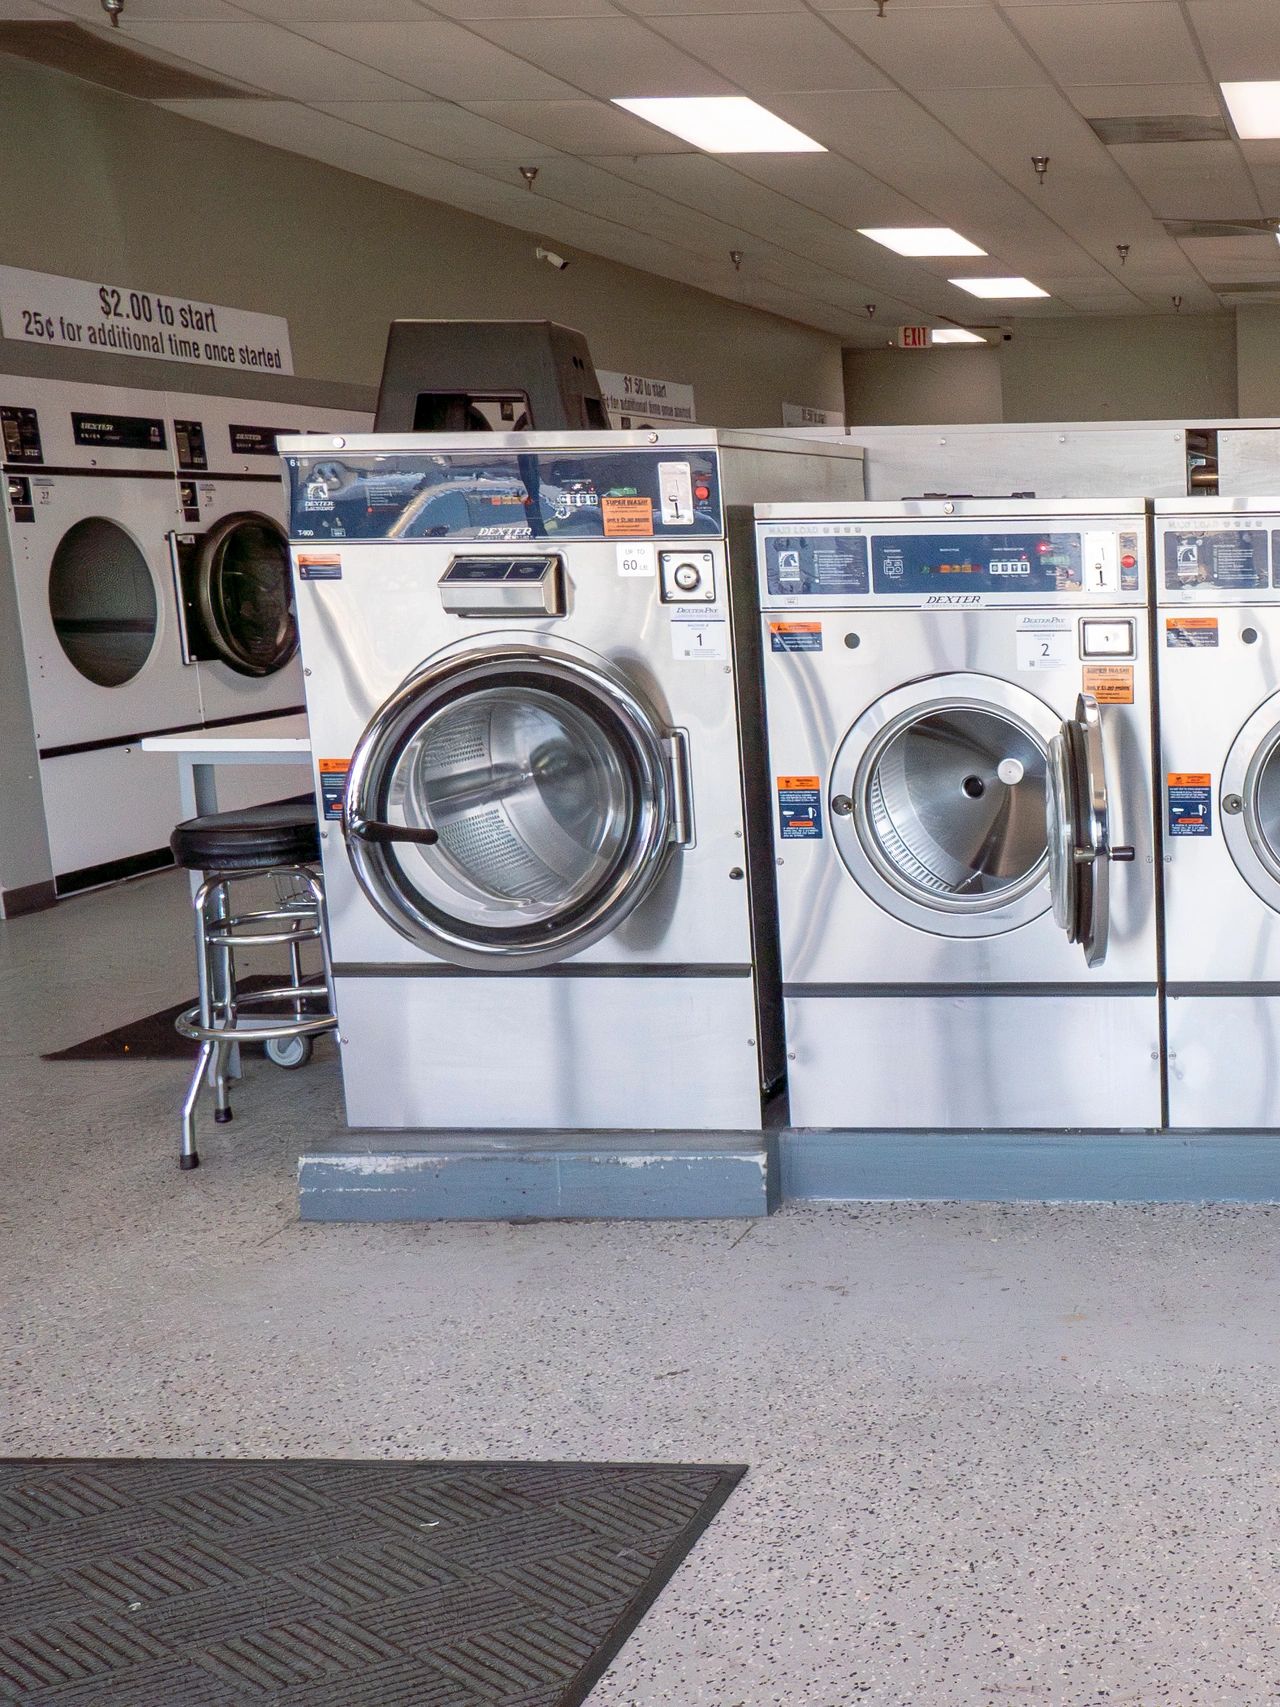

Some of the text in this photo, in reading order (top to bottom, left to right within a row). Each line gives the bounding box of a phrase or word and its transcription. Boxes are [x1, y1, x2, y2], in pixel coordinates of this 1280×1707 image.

[100, 286, 217, 333] $2.00 to start
[22, 310, 282, 369] 25¢ for additional time once started
[903, 327, 928, 346] EXIT
[289, 459, 296, 467] 6
[479, 527, 532, 536] DEXTER
[622, 559, 638, 571] 60
[926, 595, 981, 604] DEXTER
[696, 633, 703, 646] 1
[1041, 643, 1050, 657] 2
